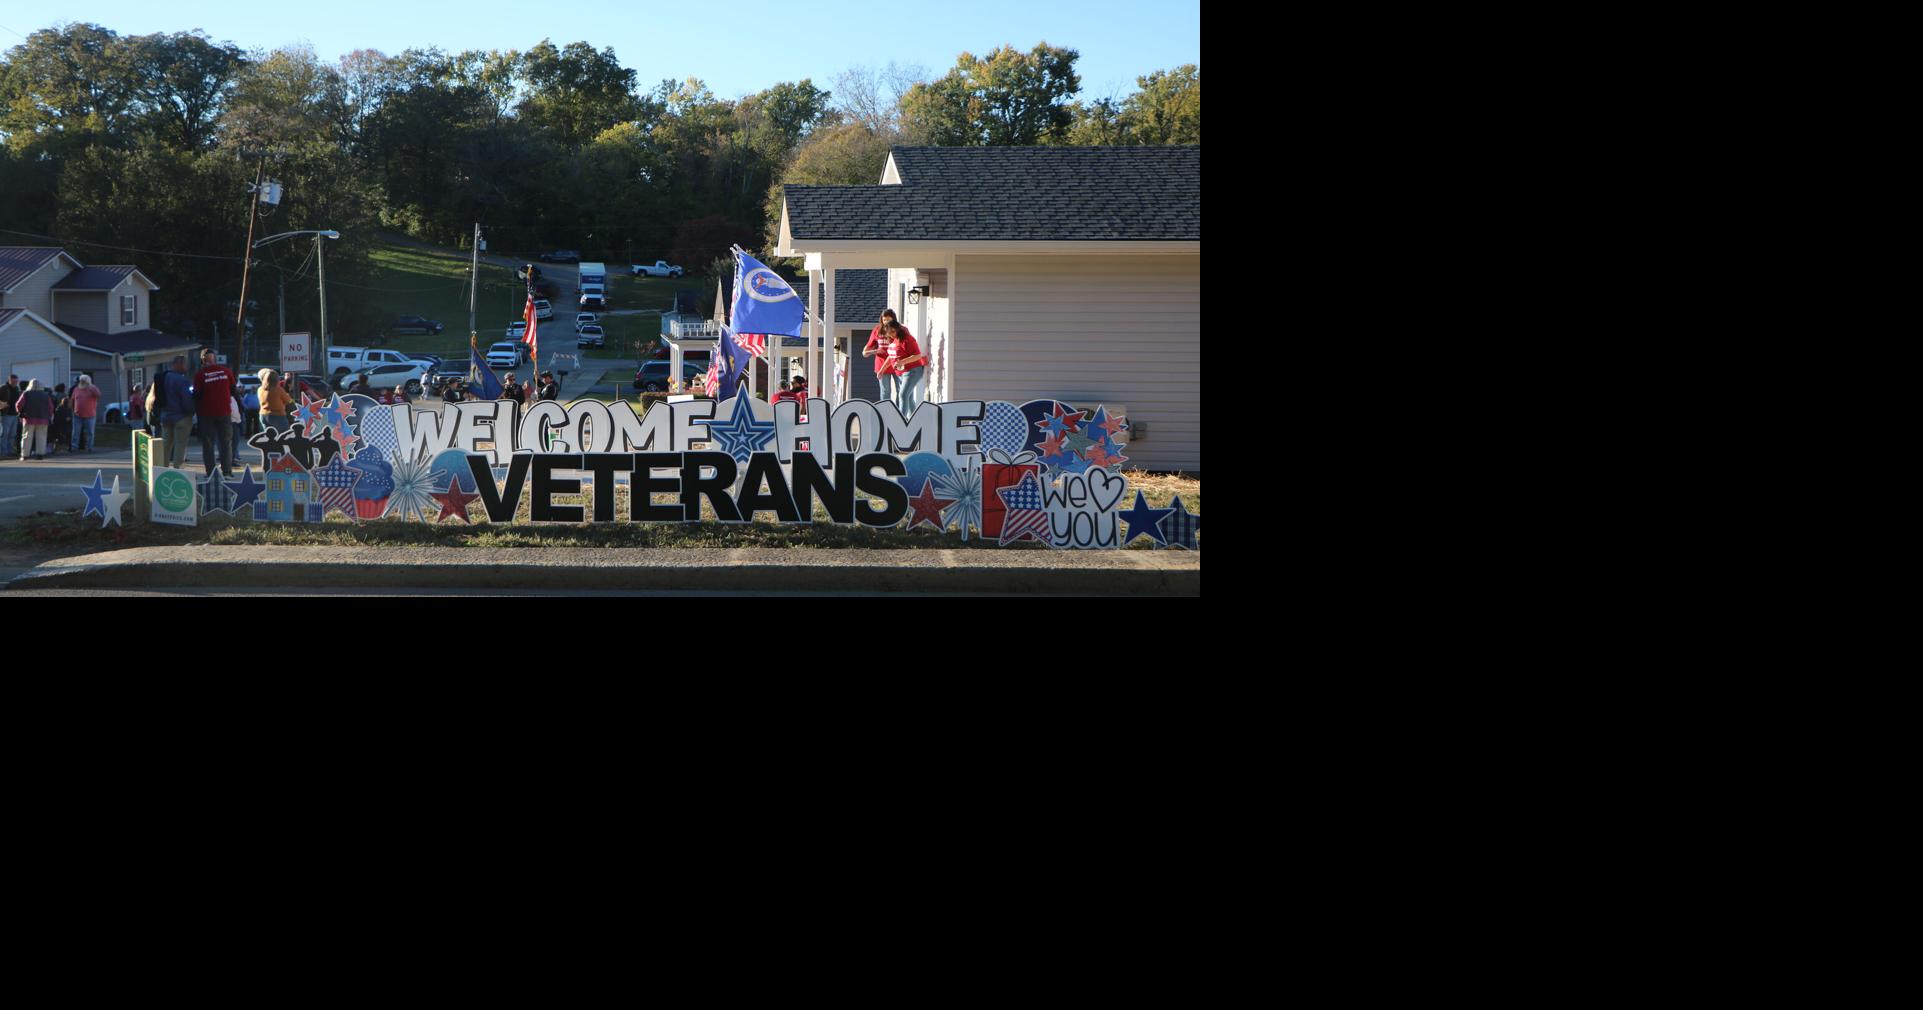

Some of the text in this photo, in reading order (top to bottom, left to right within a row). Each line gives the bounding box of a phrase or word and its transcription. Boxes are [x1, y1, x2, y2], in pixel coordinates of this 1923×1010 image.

[288, 343, 303, 352] NO
[391, 398, 986, 471] WELCOME HOME
[466, 452, 910, 529] VETERANS
